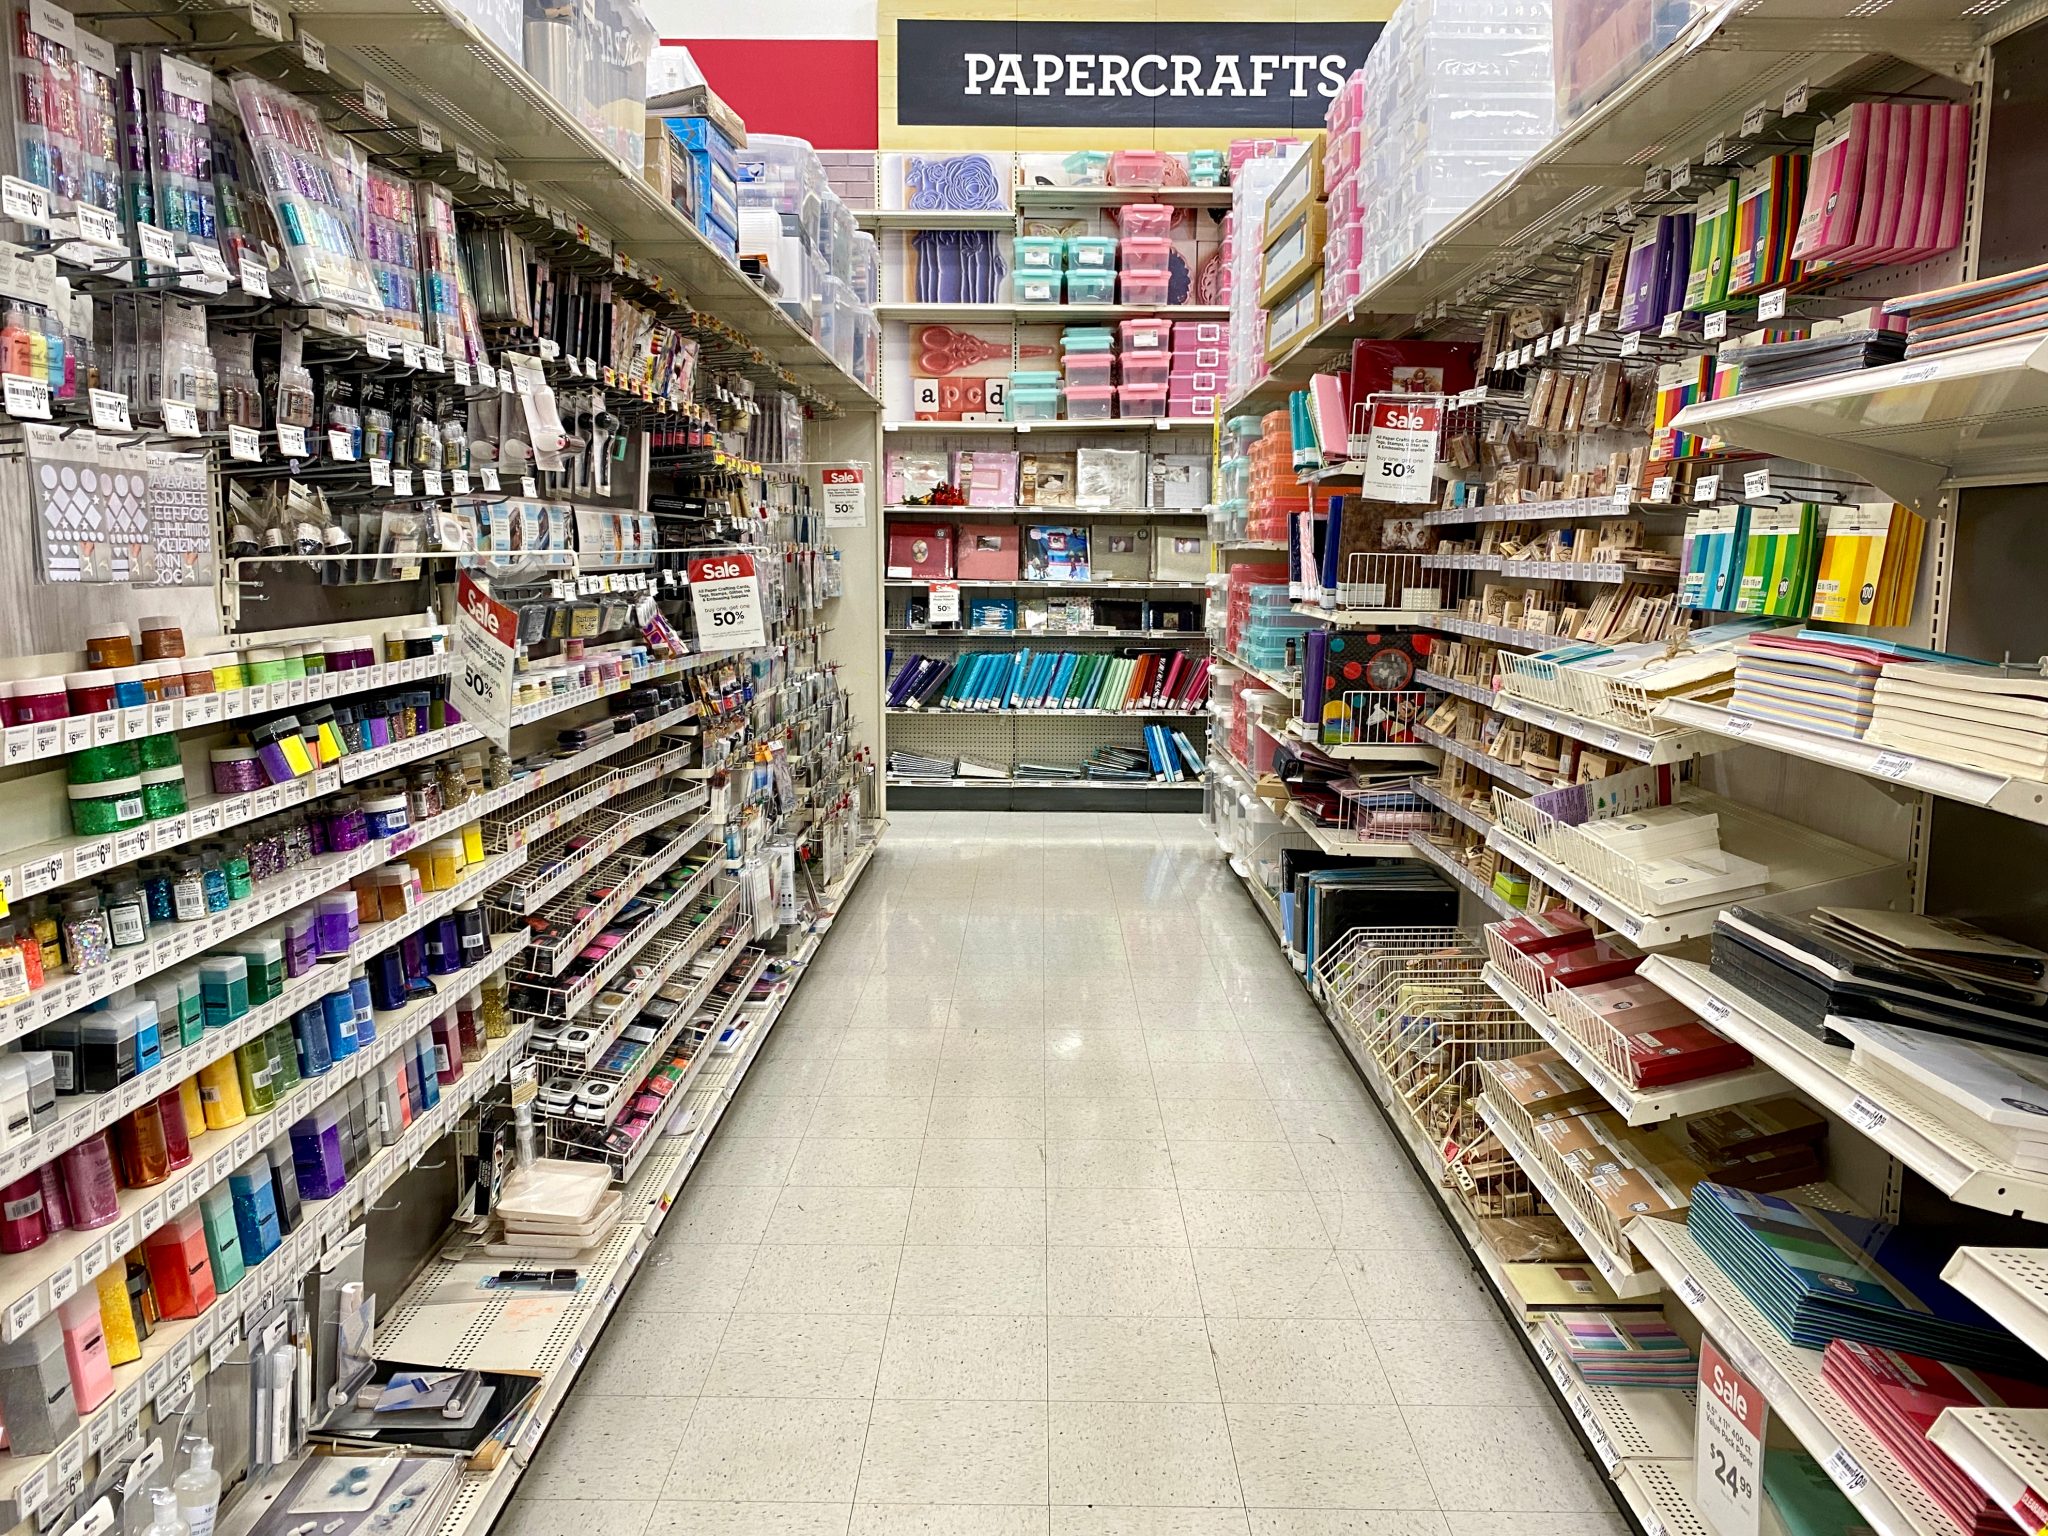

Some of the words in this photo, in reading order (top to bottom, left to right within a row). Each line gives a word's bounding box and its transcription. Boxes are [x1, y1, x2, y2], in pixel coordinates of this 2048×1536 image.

[964, 53, 1347, 98] PAPERCRAFTS
[922, 388, 936, 403] a
[990, 384, 1004, 405] d
[1386, 410, 1423, 429] Sale
[32, 430, 56, 442] Martha
[831, 472, 854, 483] Sale
[1382, 462, 1415, 477] 50%
[703, 561, 740, 579] Sale
[1862, 586, 1873, 600] 100
[467, 589, 499, 634] Sale
[714, 611, 744, 626] 50%
[465, 664, 493, 700] 50%
[1713, 1364, 1747, 1421] Sale
[1706, 1412, 1721, 1434] Value
[1722, 1429, 1734, 1449] Pack
[1736, 1444, 1753, 1468] Paper
[1731, 1426, 1744, 1448] 400
